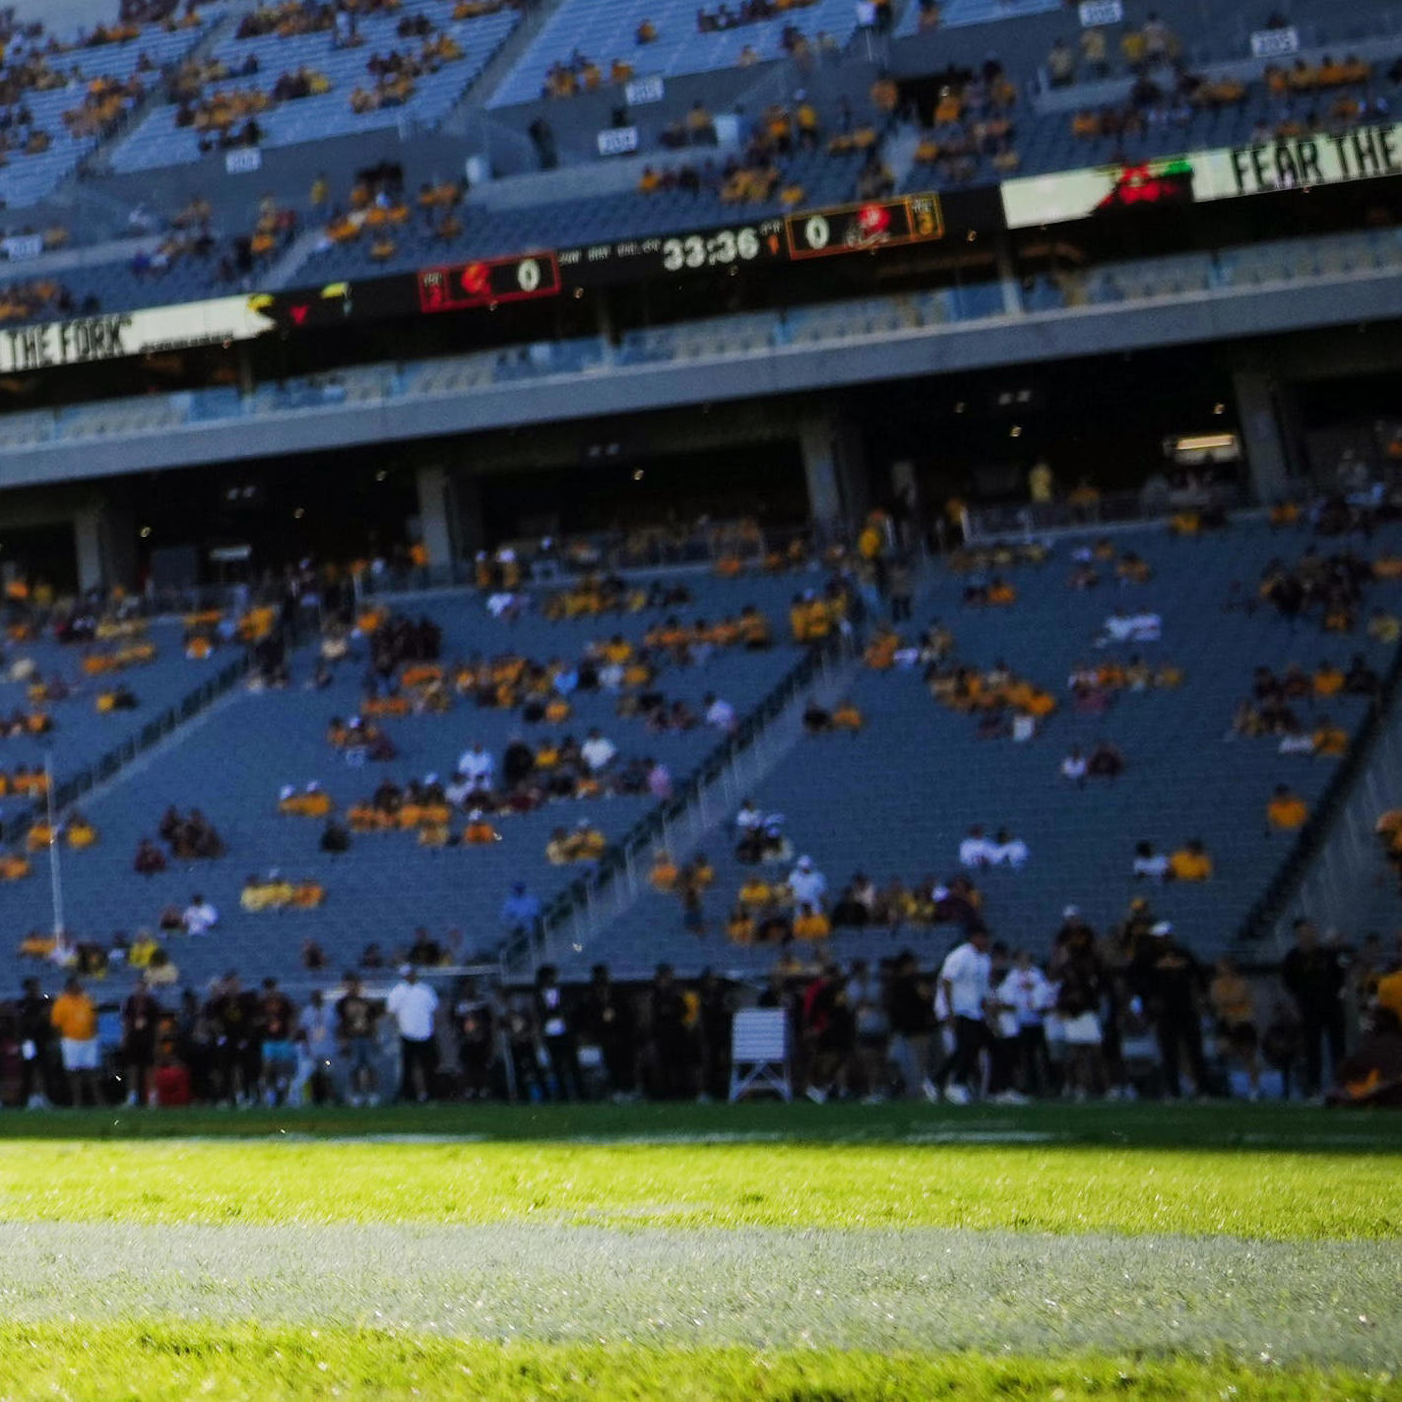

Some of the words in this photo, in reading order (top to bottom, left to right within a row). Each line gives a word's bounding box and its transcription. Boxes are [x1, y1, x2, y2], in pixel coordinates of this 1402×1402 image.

[1230, 138, 1324, 196] FEAR
[1327, 123, 1402, 180] THE
[804, 214, 830, 250] 0
[516, 258, 541, 293] 0
